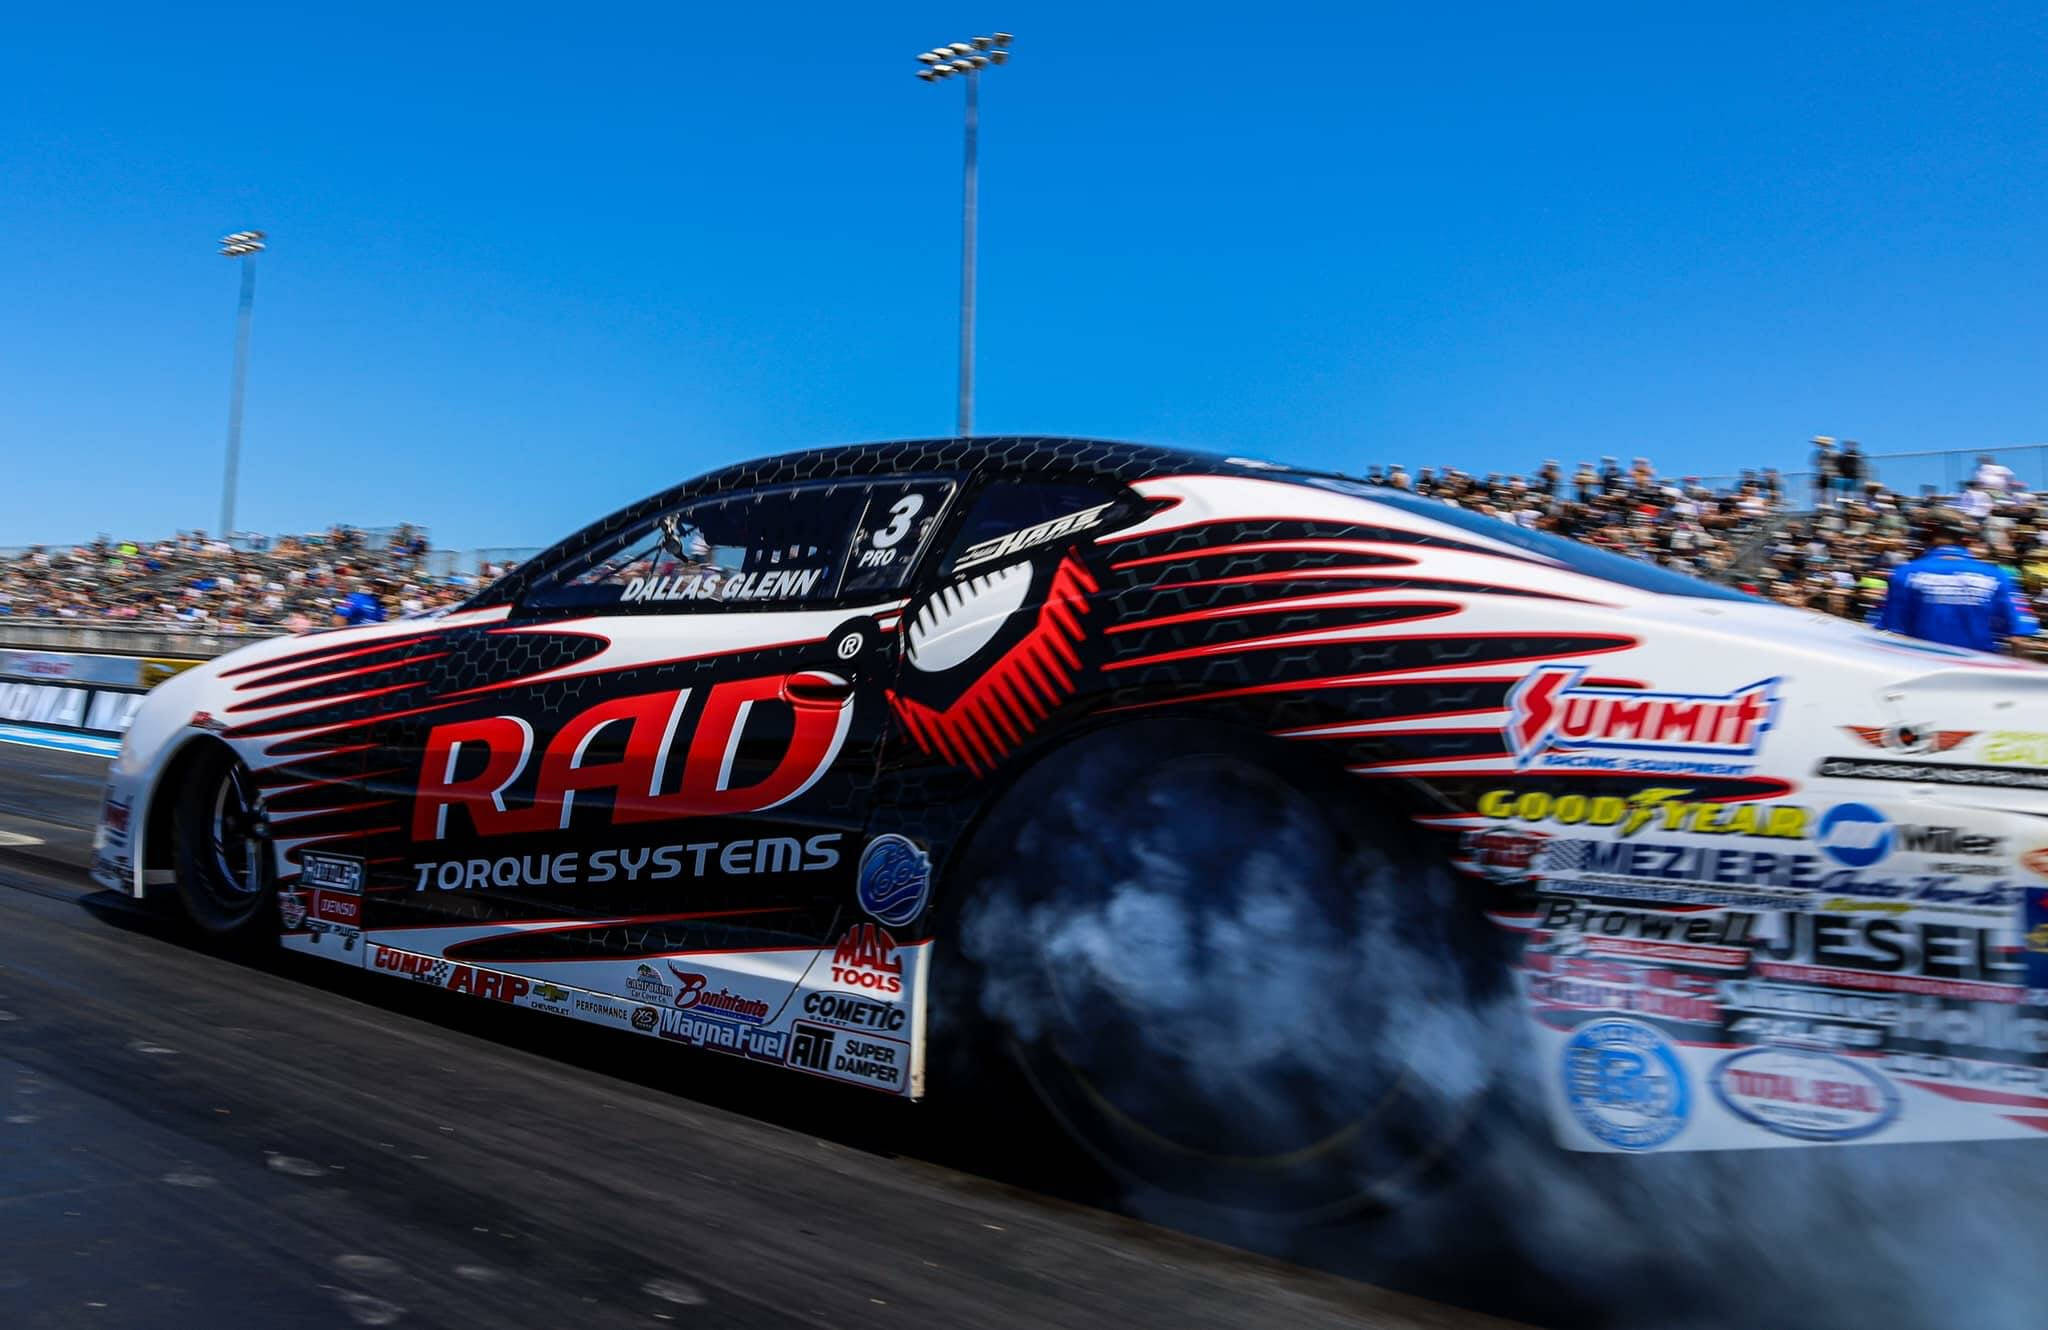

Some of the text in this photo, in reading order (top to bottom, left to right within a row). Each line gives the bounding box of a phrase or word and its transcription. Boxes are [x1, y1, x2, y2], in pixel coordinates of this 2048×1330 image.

[873, 494, 924, 549] 3
[857, 549, 897, 567] PRO
[620, 568, 821, 601] DALLAS GLENN
[411, 670, 856, 842] RAD
[1479, 787, 1812, 839] GOODYEAR
[414, 853, 578, 892] TORQUE
[588, 833, 843, 882] SYSTEMS
[320, 899, 356, 916] DENSO
[374, 946, 433, 975] COMP
[1757, 911, 2027, 978] JESEL
[447, 965, 530, 1004] ARP
[626, 977, 673, 998] CALIFORNIA
[832, 967, 901, 993] TOOLS
[531, 1001, 570, 1016] CHEVROLET
[576, 1000, 628, 1021] PERFORMANCE
[804, 992, 905, 1031] COMETIC
[662, 1009, 788, 1059] MagnaFuel
[789, 1023, 835, 1071] ATI
[845, 1039, 896, 1064] SUPER
[834, 1055, 899, 1083] DAMPER
